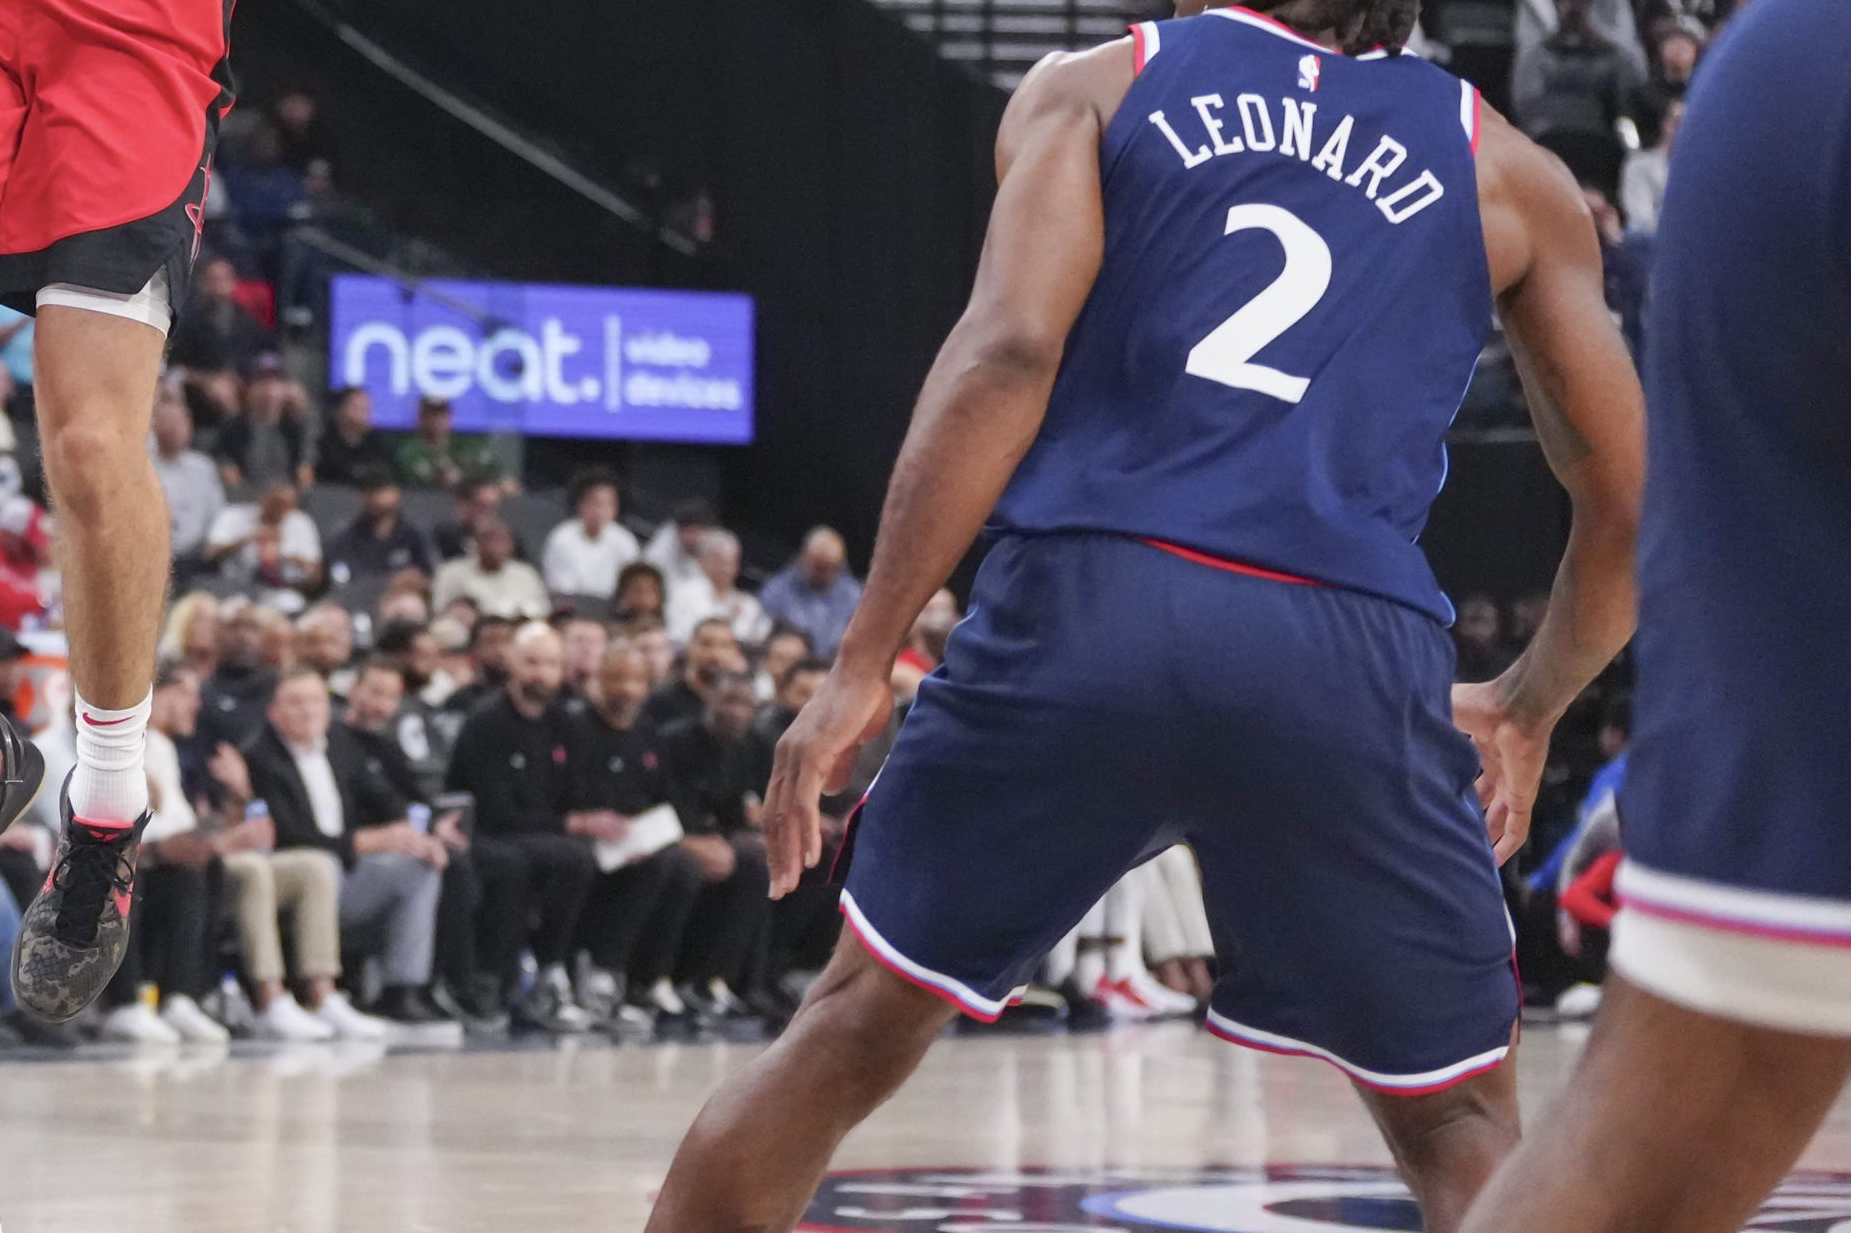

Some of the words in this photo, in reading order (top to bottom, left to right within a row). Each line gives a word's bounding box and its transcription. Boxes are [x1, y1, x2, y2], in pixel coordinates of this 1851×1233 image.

[1149, 93, 1444, 224] LEONARD
[344, 316, 601, 404] neat.
[1185, 203, 1332, 403] 2
